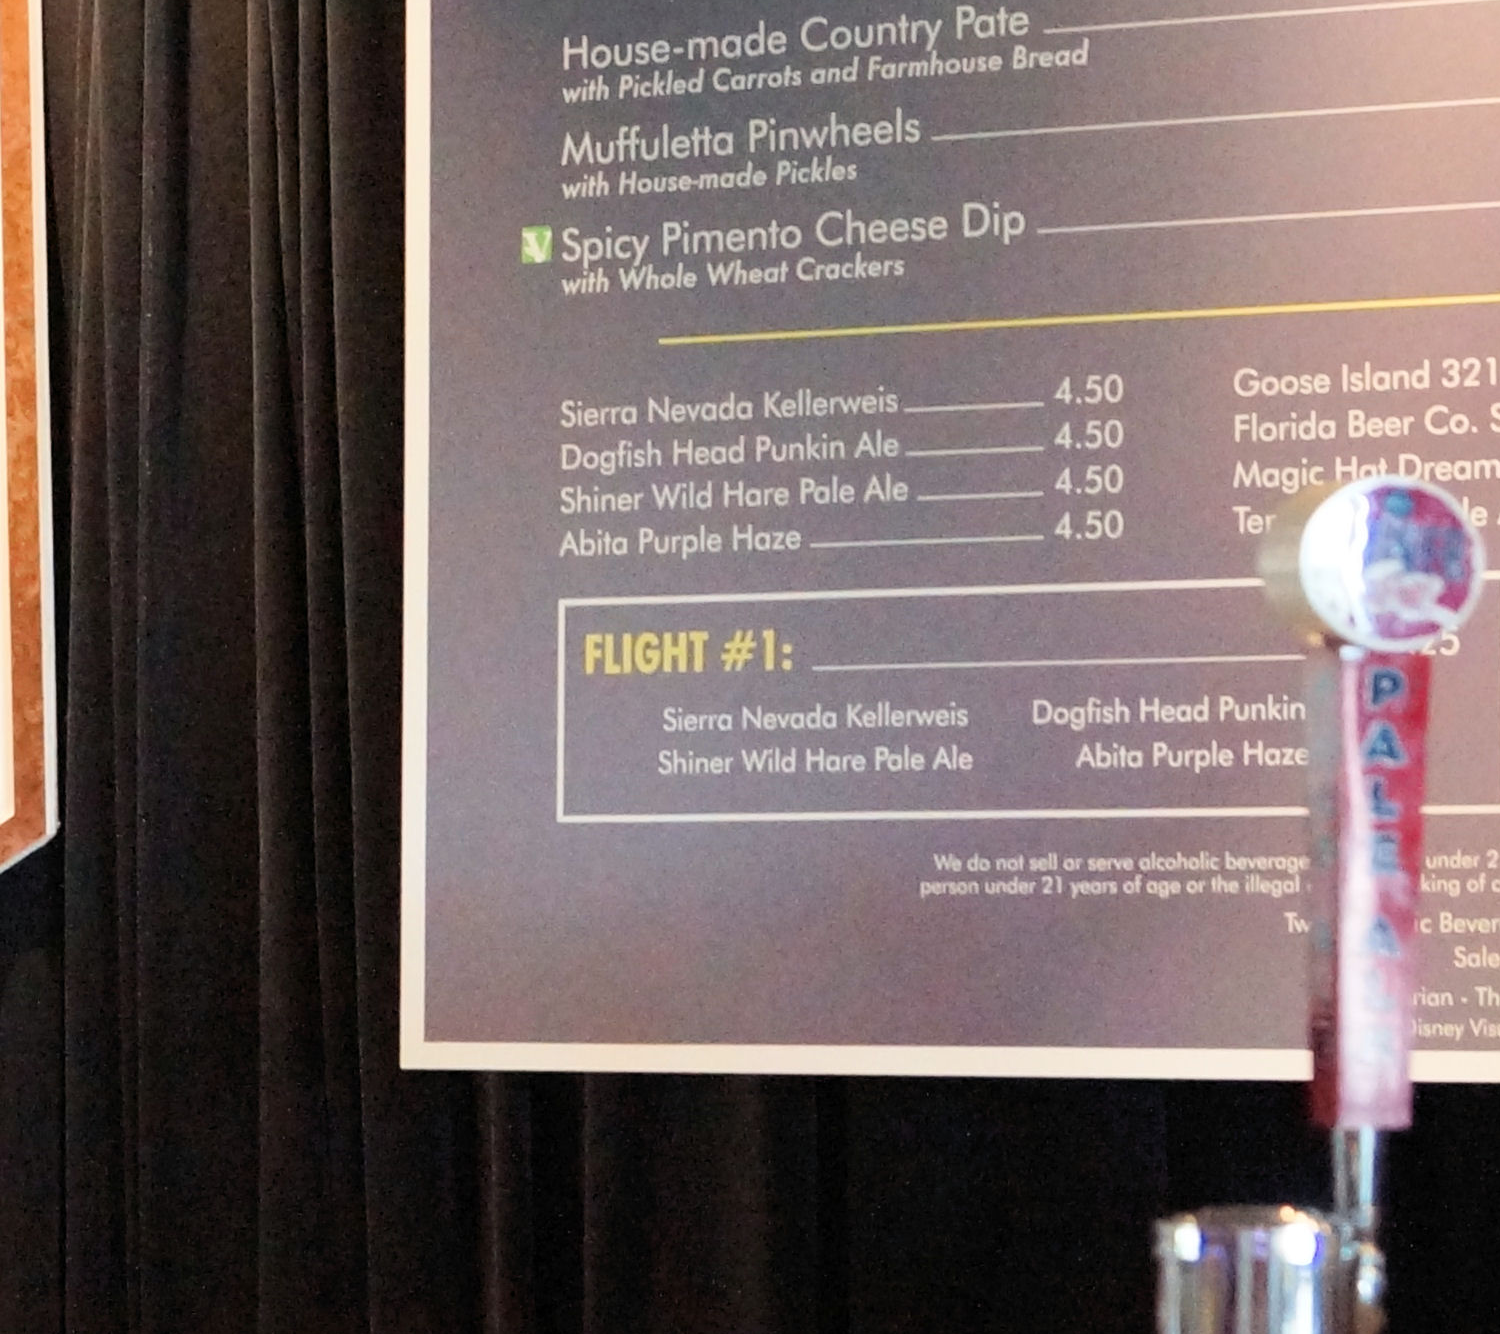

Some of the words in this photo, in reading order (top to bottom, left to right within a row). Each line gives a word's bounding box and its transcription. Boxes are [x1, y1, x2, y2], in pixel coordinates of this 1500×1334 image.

[561, 73, 610, 104] with
[617, 66, 706, 100] Pickled
[711, 64, 803, 93] Carrots
[809, 55, 860, 85] and
[866, 49, 1003, 82] Farmhouse
[1012, 37, 1090, 71] Bread
[562, 19, 788, 84] House-made
[800, 13, 943, 63] Country
[955, 4, 1030, 50] Pate
[560, 122, 735, 167] Muffuletta
[748, 106, 921, 154] Pinwheels
[560, 170, 610, 200] with
[618, 159, 768, 196] House-made
[775, 154, 858, 186] Pickles
[561, 224, 654, 272] Spicy
[662, 219, 803, 268] Pimento
[814, 208, 949, 257] Cheese
[962, 200, 1026, 245] Dip
[560, 266, 610, 296] with
[618, 261, 698, 292] Whole
[706, 257, 790, 287] Wheat
[795, 250, 905, 282] Crackers
[560, 399, 638, 429] Sierra
[647, 390, 754, 424] Nevada
[763, 385, 899, 419] Kellerweis
[1054, 373, 1124, 405] 4.50
[1233, 366, 1332, 398] Goose
[1341, 358, 1431, 394] Island
[1440, 355, 1498, 389] 321
[560, 438, 663, 477] Dogfish
[671, 434, 746, 467] Head
[754, 432, 846, 463] Punkin
[853, 428, 900, 459] Ale
[1054, 418, 1124, 450] 4.50
[1234, 409, 1337, 443] Florida
[1347, 408, 1416, 439] Beer
[1423, 404, 1479, 436] Co.
[560, 484, 645, 515] Shiner
[650, 480, 713, 511] Wild
[723, 479, 790, 508] Hare
[799, 474, 856, 505] Pale
[862, 472, 910, 503] Ale
[1054, 462, 1124, 496] 4.50
[559, 528, 629, 558] Abita
[637, 523, 723, 561] Purple
[731, 523, 803, 552] Haze
[1054, 508, 1124, 541] 4.50
[584, 630, 710, 675] FLIGHT
[720, 628, 794, 673] #1:
[1364, 667, 1407, 876] PALE
